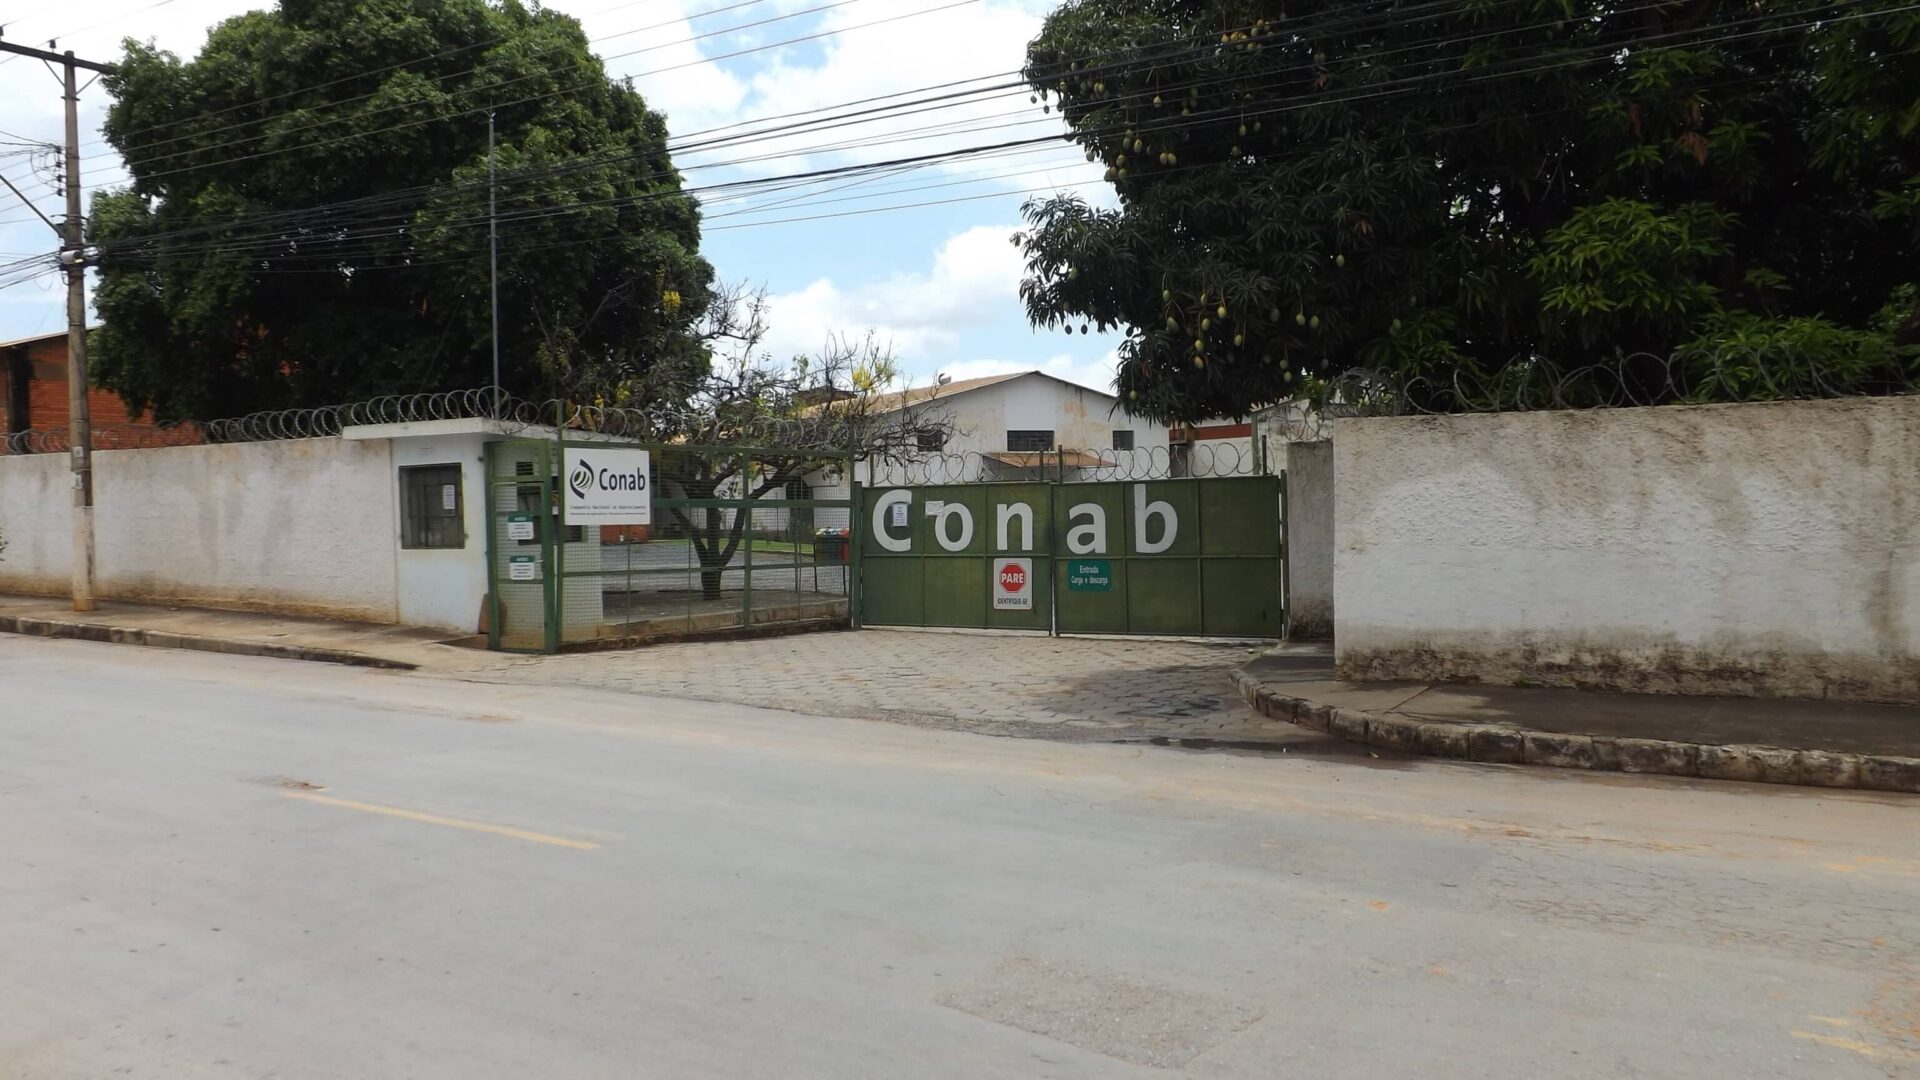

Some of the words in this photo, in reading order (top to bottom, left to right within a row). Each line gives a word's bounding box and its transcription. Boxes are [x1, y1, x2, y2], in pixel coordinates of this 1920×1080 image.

[599, 467, 646, 491] Conab
[872, 483, 1178, 554] Conab
[1079, 565, 1099, 574] Entrada
[1001, 573, 1024, 584] PARE
[1071, 576, 1083, 585] Carga
[1089, 576, 1108, 585] descarga
